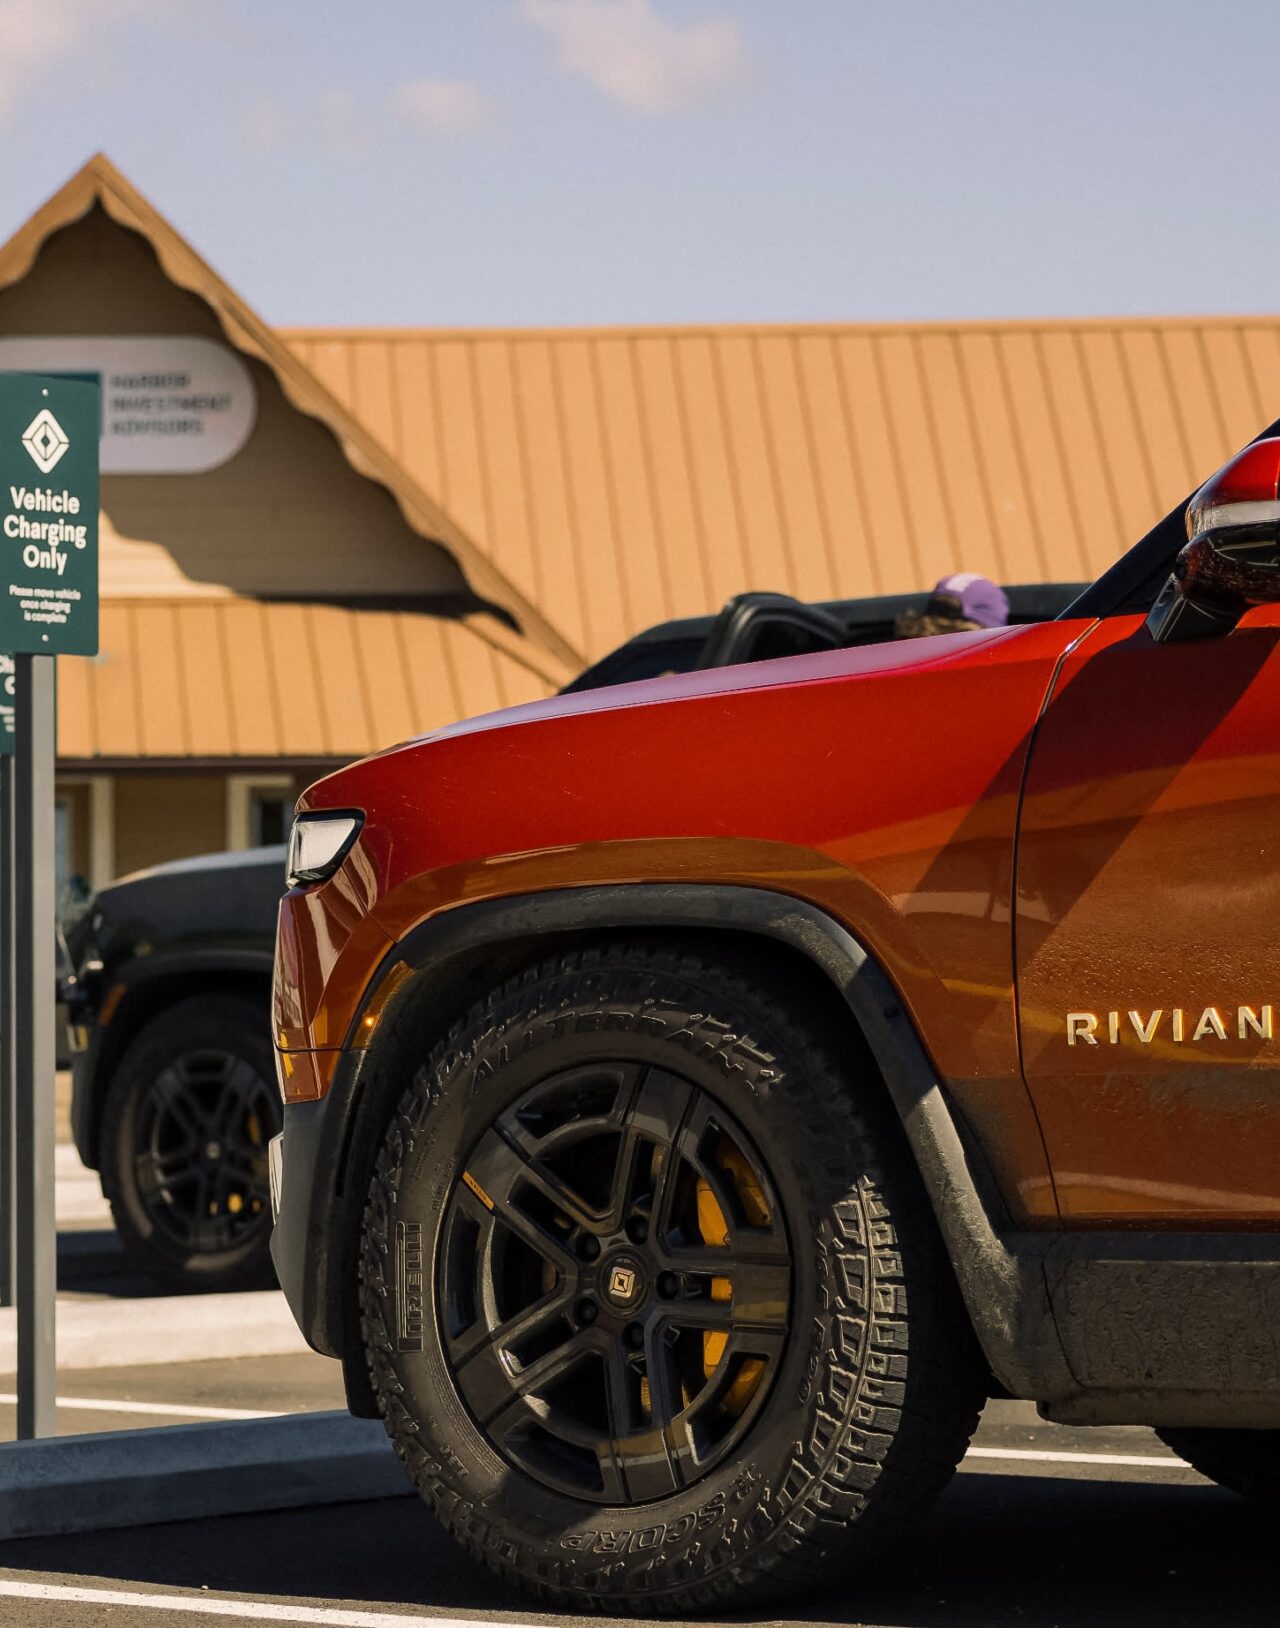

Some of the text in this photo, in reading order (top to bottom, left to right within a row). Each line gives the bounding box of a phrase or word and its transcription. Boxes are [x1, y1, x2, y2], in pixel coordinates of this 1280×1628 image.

[10, 486, 81, 514] Vehicle
[3, 514, 87, 549] Charging
[23, 544, 68, 576] Only
[9, 584, 81, 600] Please move vehicle
[20, 600, 71, 614] once charging
[31, 612, 67, 624] complete
[1066, 1005, 1273, 1046] RIVIAN
[396, 1220, 423, 1352] PIRELLI
[560, 1491, 726, 1554] SCORP
